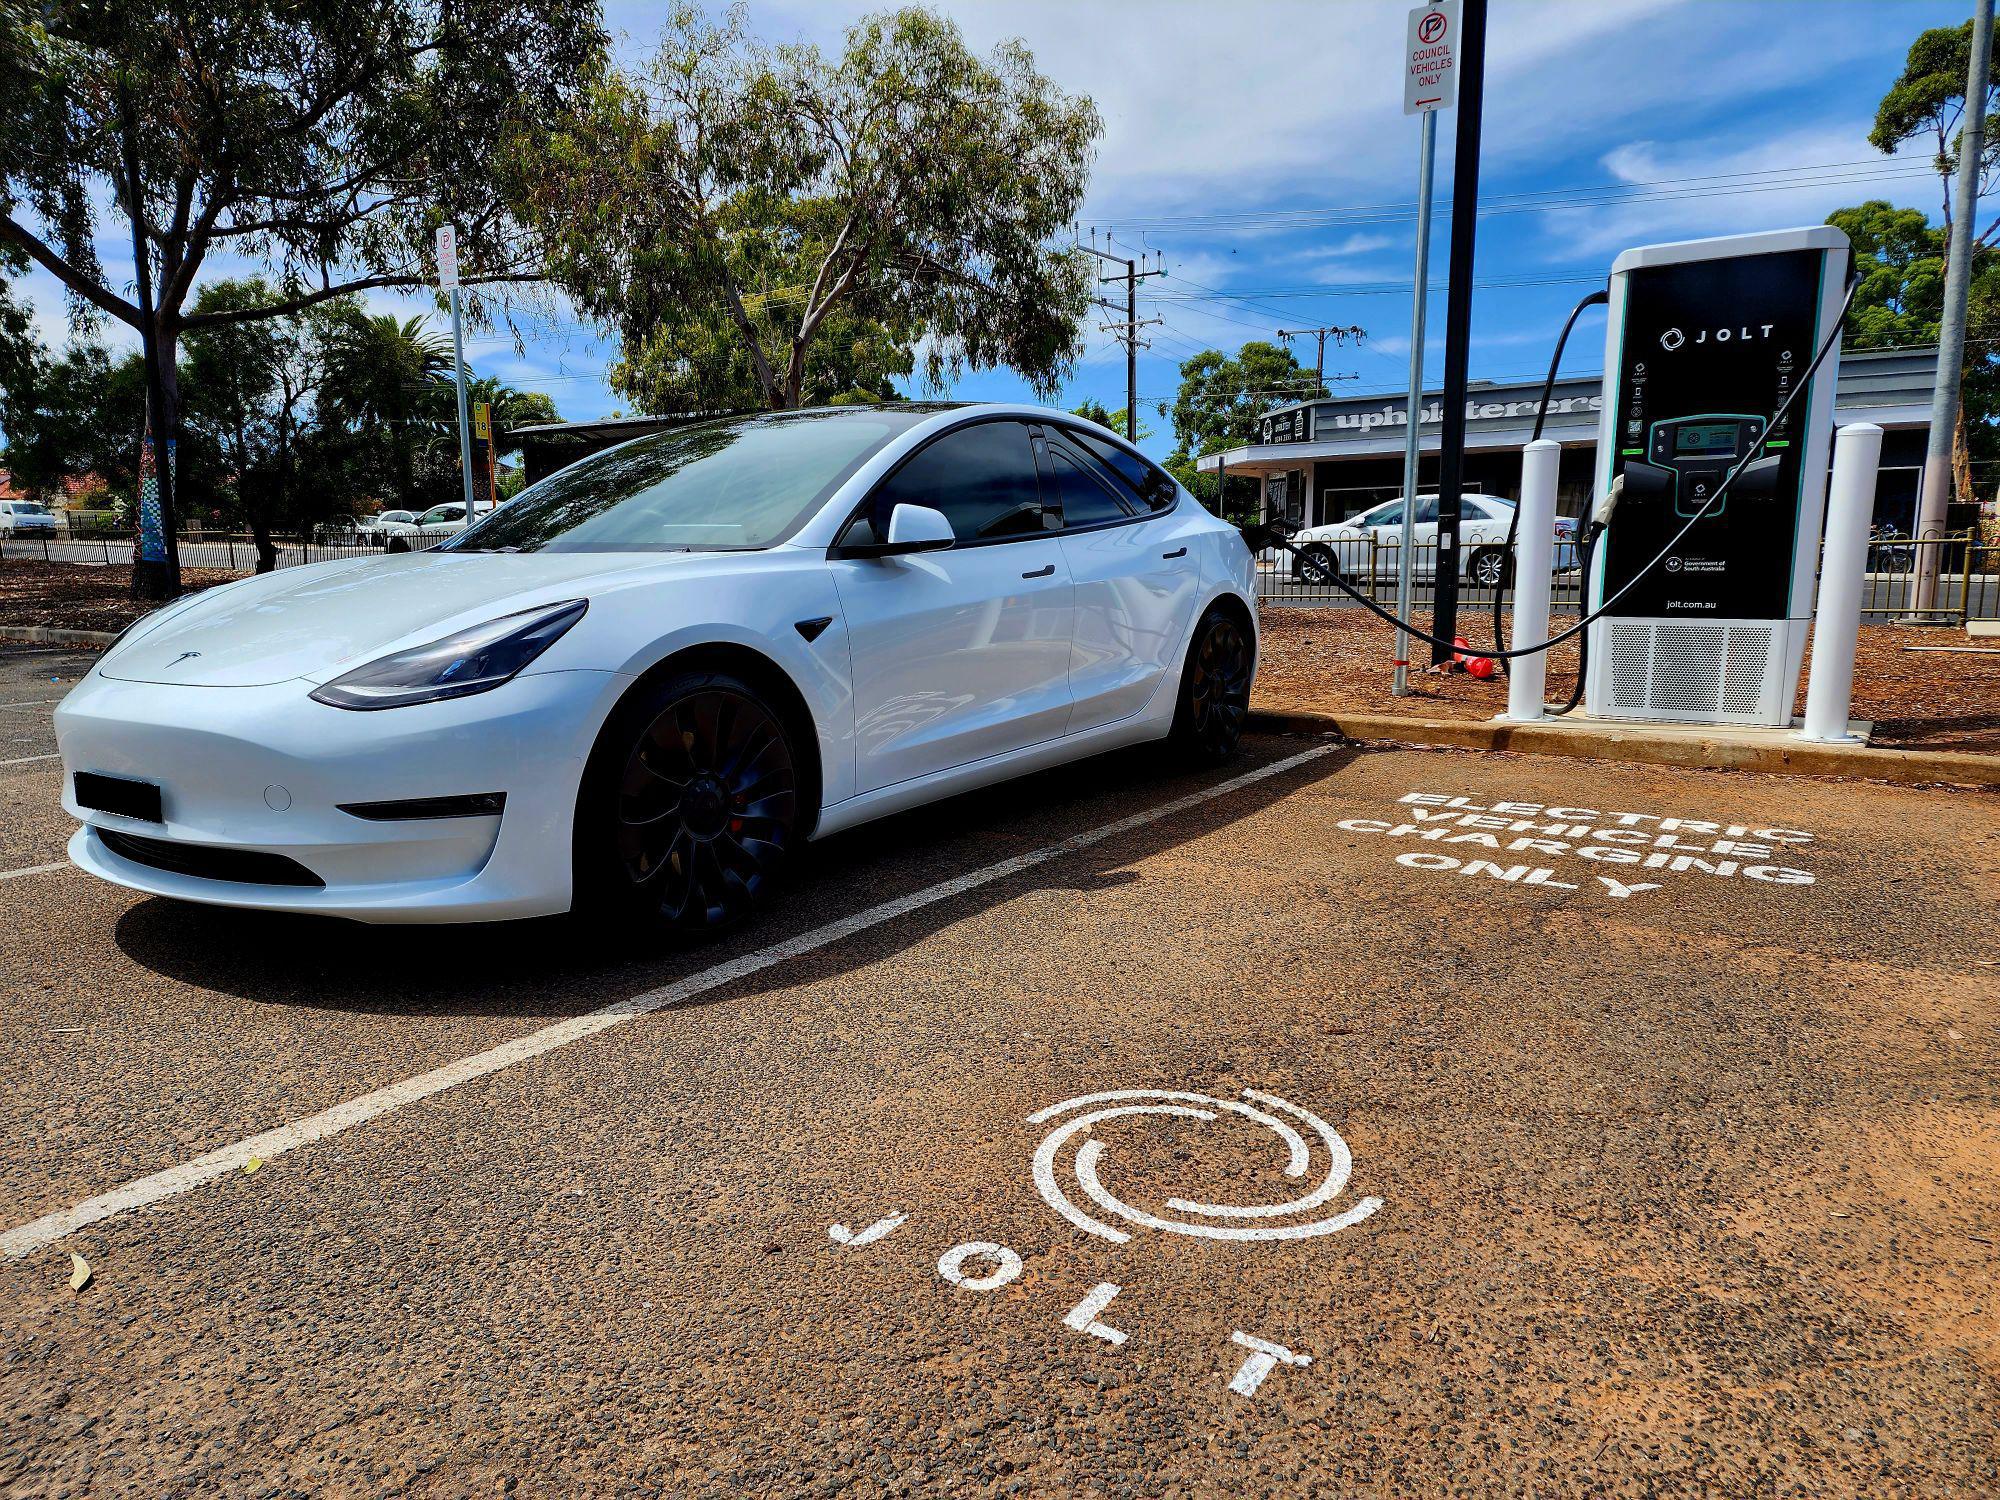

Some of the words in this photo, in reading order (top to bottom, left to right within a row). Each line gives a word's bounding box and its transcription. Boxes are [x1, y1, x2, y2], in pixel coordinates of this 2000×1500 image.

[1411, 58, 1453, 75] VEHICLES
[1413, 45, 1451, 62] COUNCIL
[1419, 73, 1442, 87] ONLY
[1695, 324, 1774, 344] JOLT
[476, 421, 487, 431] 18
[1336, 395, 1602, 433] uphlterers
[1666, 600, 1717, 610] jolt.com.au
[1397, 792, 1815, 844] ELECTRIC
[1411, 808, 1774, 859] VEHICLE
[1336, 819, 1816, 885] CHARGING
[1395, 853, 1664, 898] ONLY
[828, 1210, 1313, 1397] JOLT
